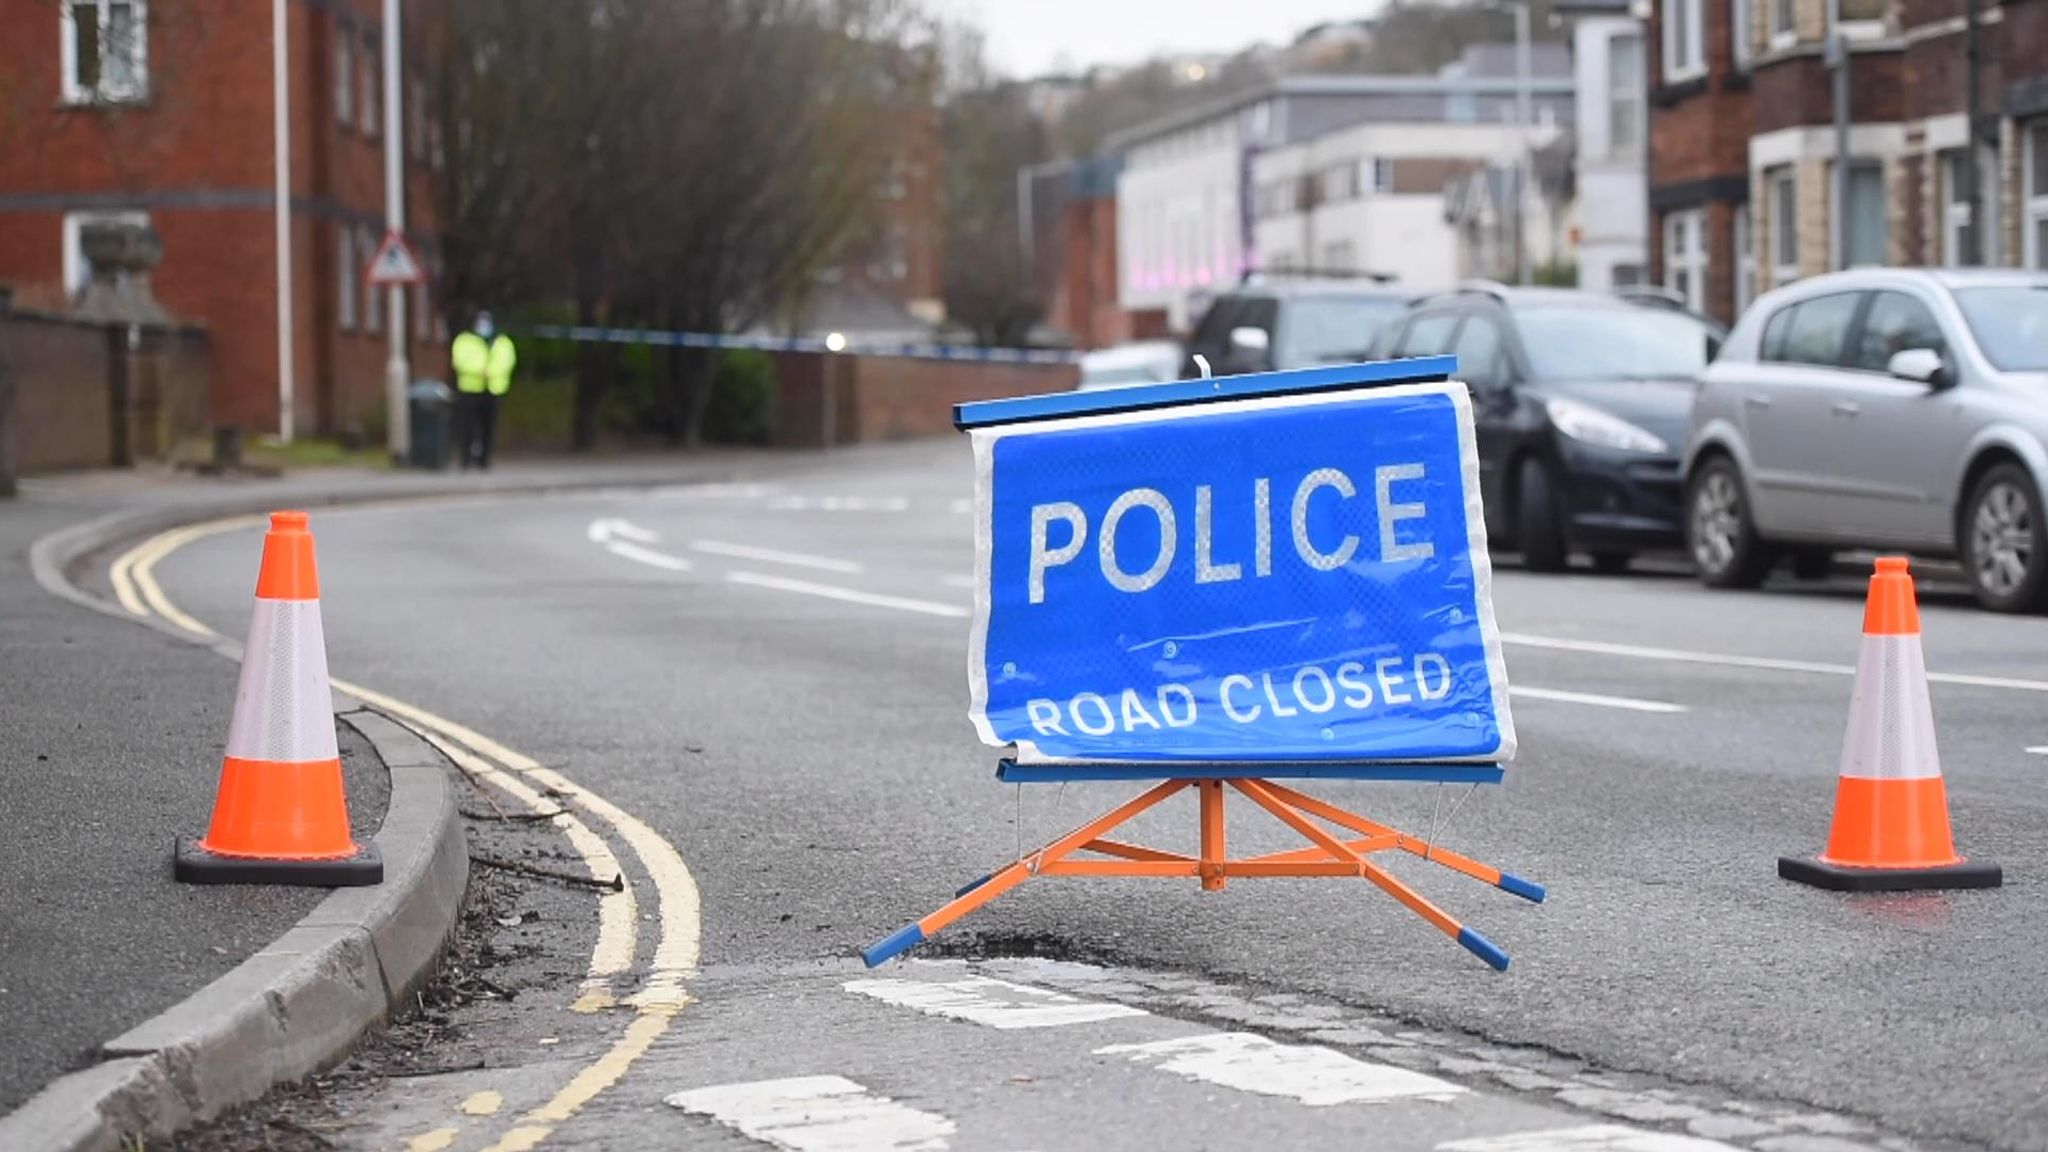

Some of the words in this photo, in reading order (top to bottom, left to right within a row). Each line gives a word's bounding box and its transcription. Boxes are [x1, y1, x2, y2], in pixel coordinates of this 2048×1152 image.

[1029, 463, 1435, 604] POLICE
[1028, 683, 1198, 736] ROAD
[1219, 653, 1451, 723] CLOSED
